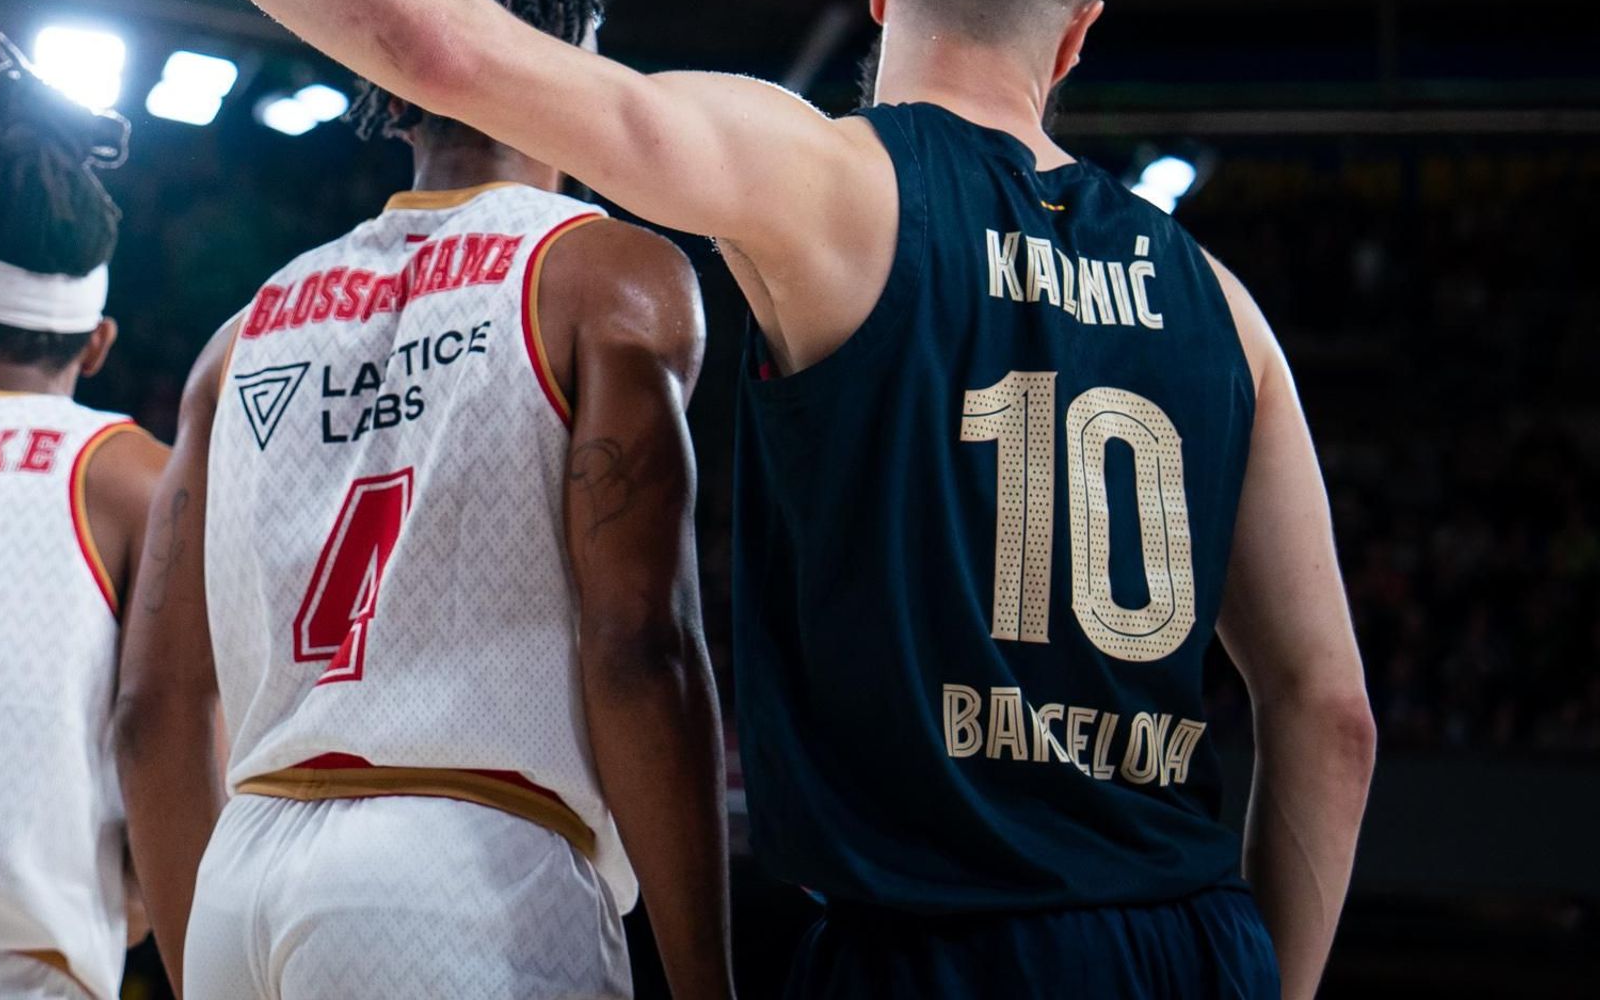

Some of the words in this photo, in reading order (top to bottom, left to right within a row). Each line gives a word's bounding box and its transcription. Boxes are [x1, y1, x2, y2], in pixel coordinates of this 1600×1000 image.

[986, 228, 1164, 330] KALNIĆ
[321, 320, 492, 398] LATICE
[321, 385, 426, 444] LABS
[958, 371, 1197, 662] 10
[293, 466, 414, 686] 4
